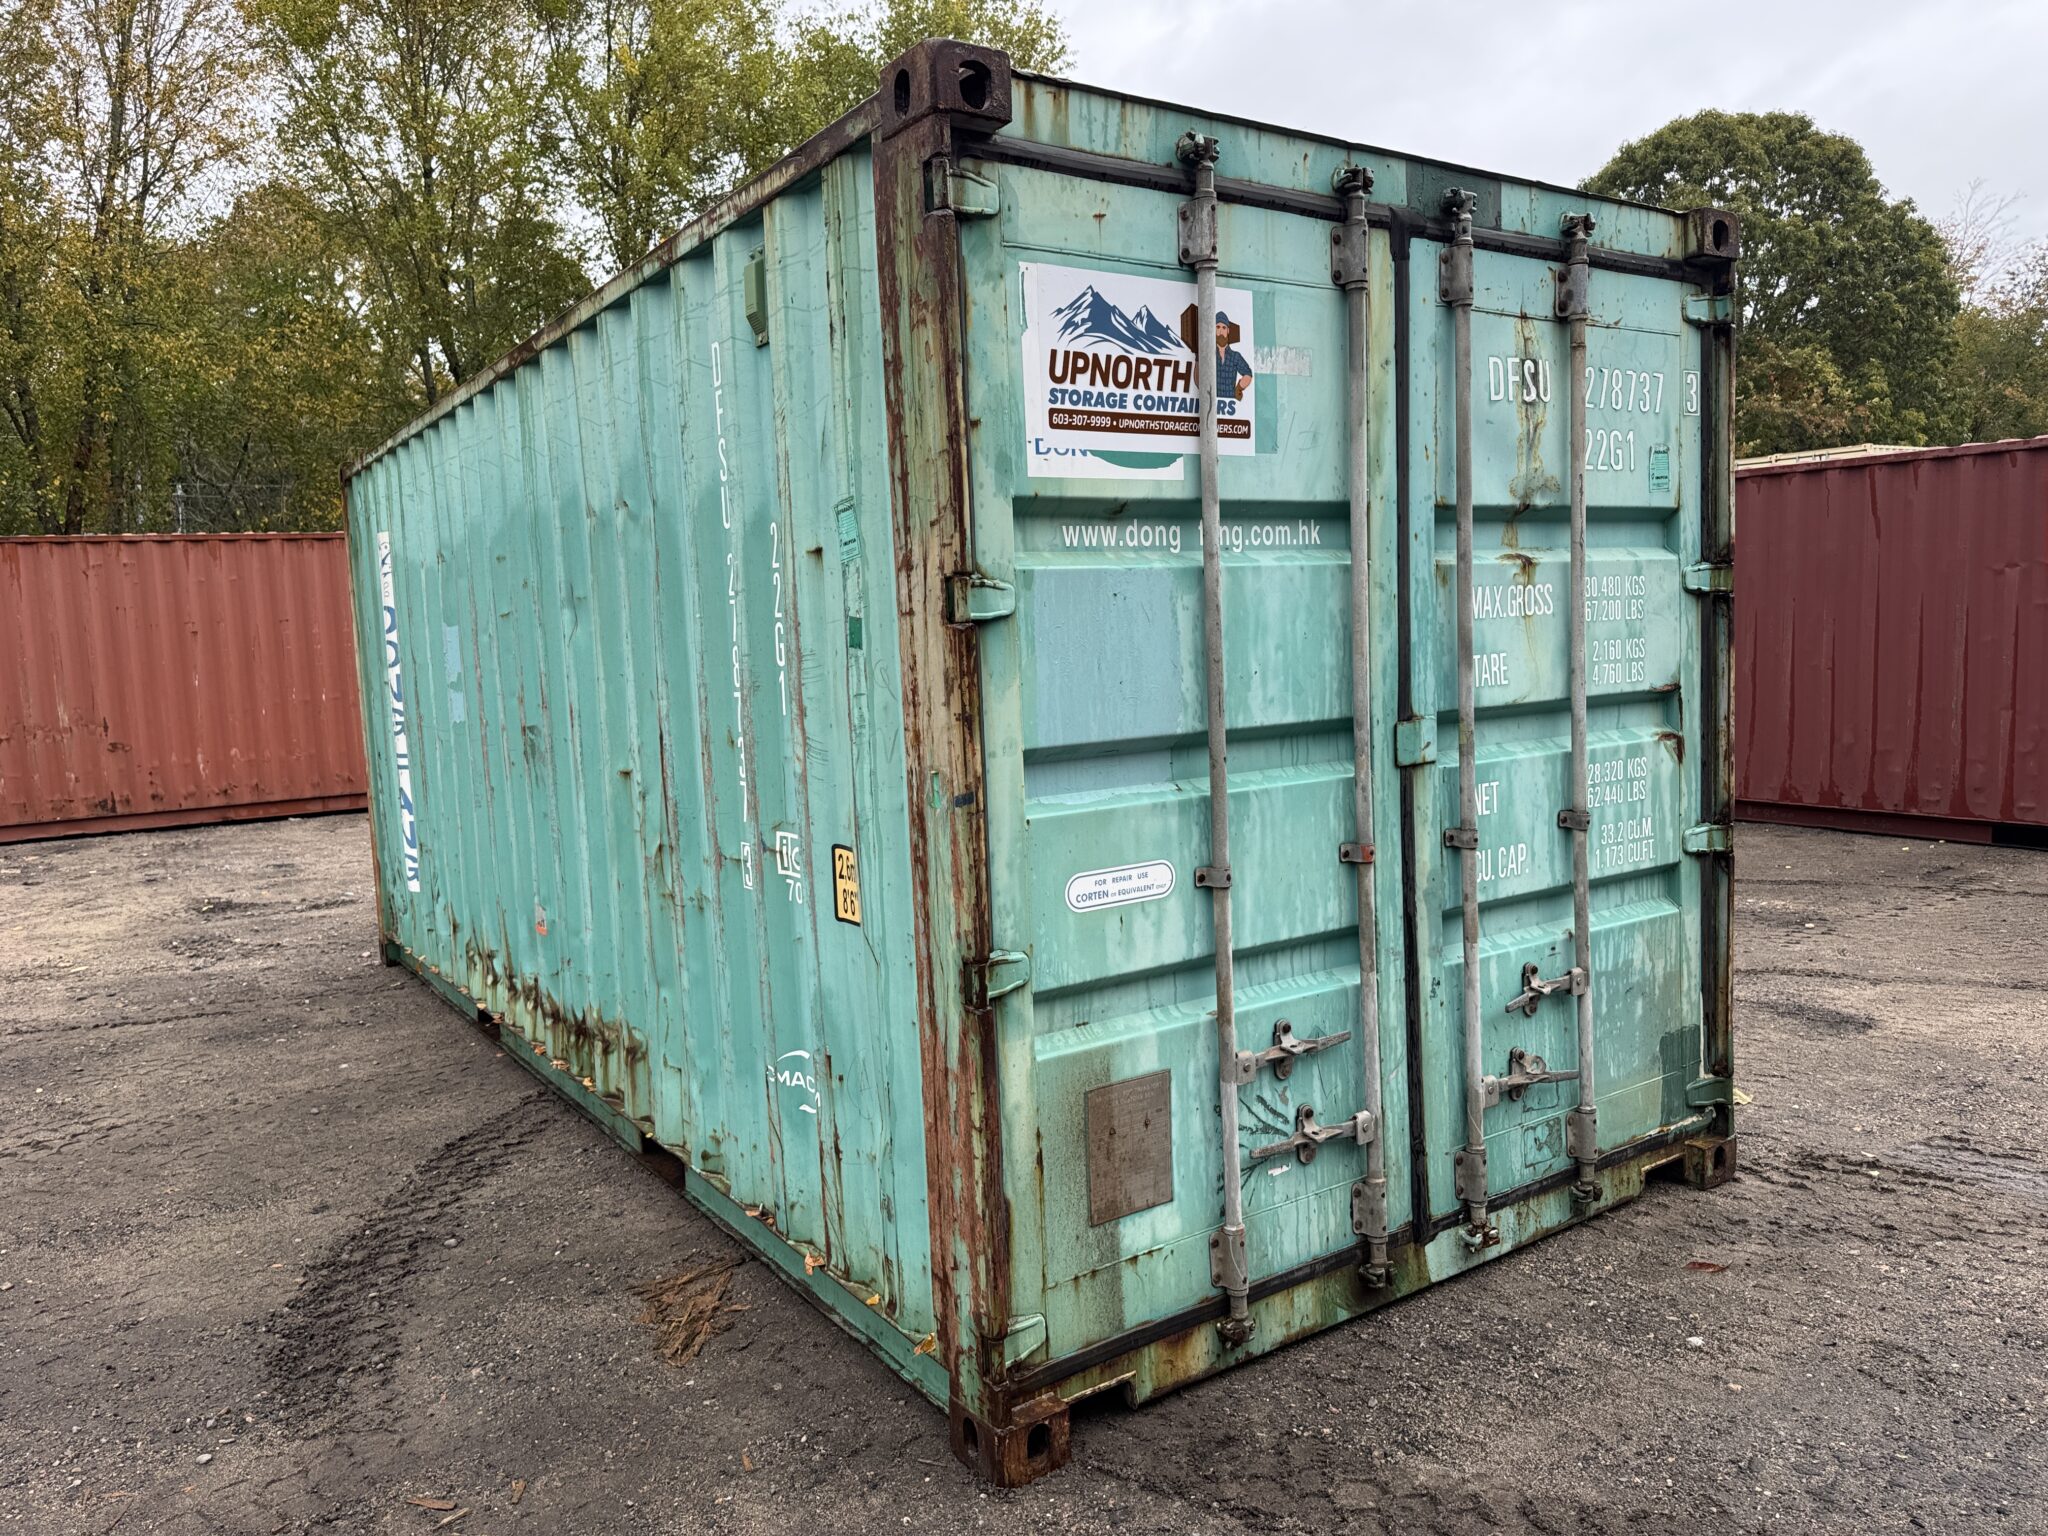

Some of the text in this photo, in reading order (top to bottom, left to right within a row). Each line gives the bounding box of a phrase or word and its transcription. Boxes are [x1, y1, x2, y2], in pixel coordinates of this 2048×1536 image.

[1049, 349, 1192, 393] UPNORTH
[1488, 356, 1697, 414] DFSU 278737 3
[1048, 388, 1236, 416] STORAGE CONTAIRS
[711, 341, 731, 529] DFSU
[1052, 413, 1249, 434] 603-307-9999 UPNORTHSTORAGECOERS.COM
[1585, 428, 1635, 471] 22G1
[1062, 518, 1321, 553] www.dong fng.com.hk
[1625, 575, 1645, 597] KGS
[770, 522, 786, 716] 22G1
[1625, 599, 1644, 620] LBS
[1473, 652, 1509, 688] TARE
[1625, 637, 1645, 660] KGS
[1625, 661, 1644, 684] LBS
[1475, 781, 1499, 816] NET
[1627, 757, 1647, 778] KGS
[1627, 780, 1646, 801] LBS
[1600, 821, 1624, 845] 33.2
[1498, 842, 1529, 879] CAP.
[786, 879, 803, 905] 70
[1075, 889, 1109, 903] CORTEN
[1118, 883, 1155, 896] EQUIVALENT
[1094, 871, 1149, 887] FOR REPAIR USE
